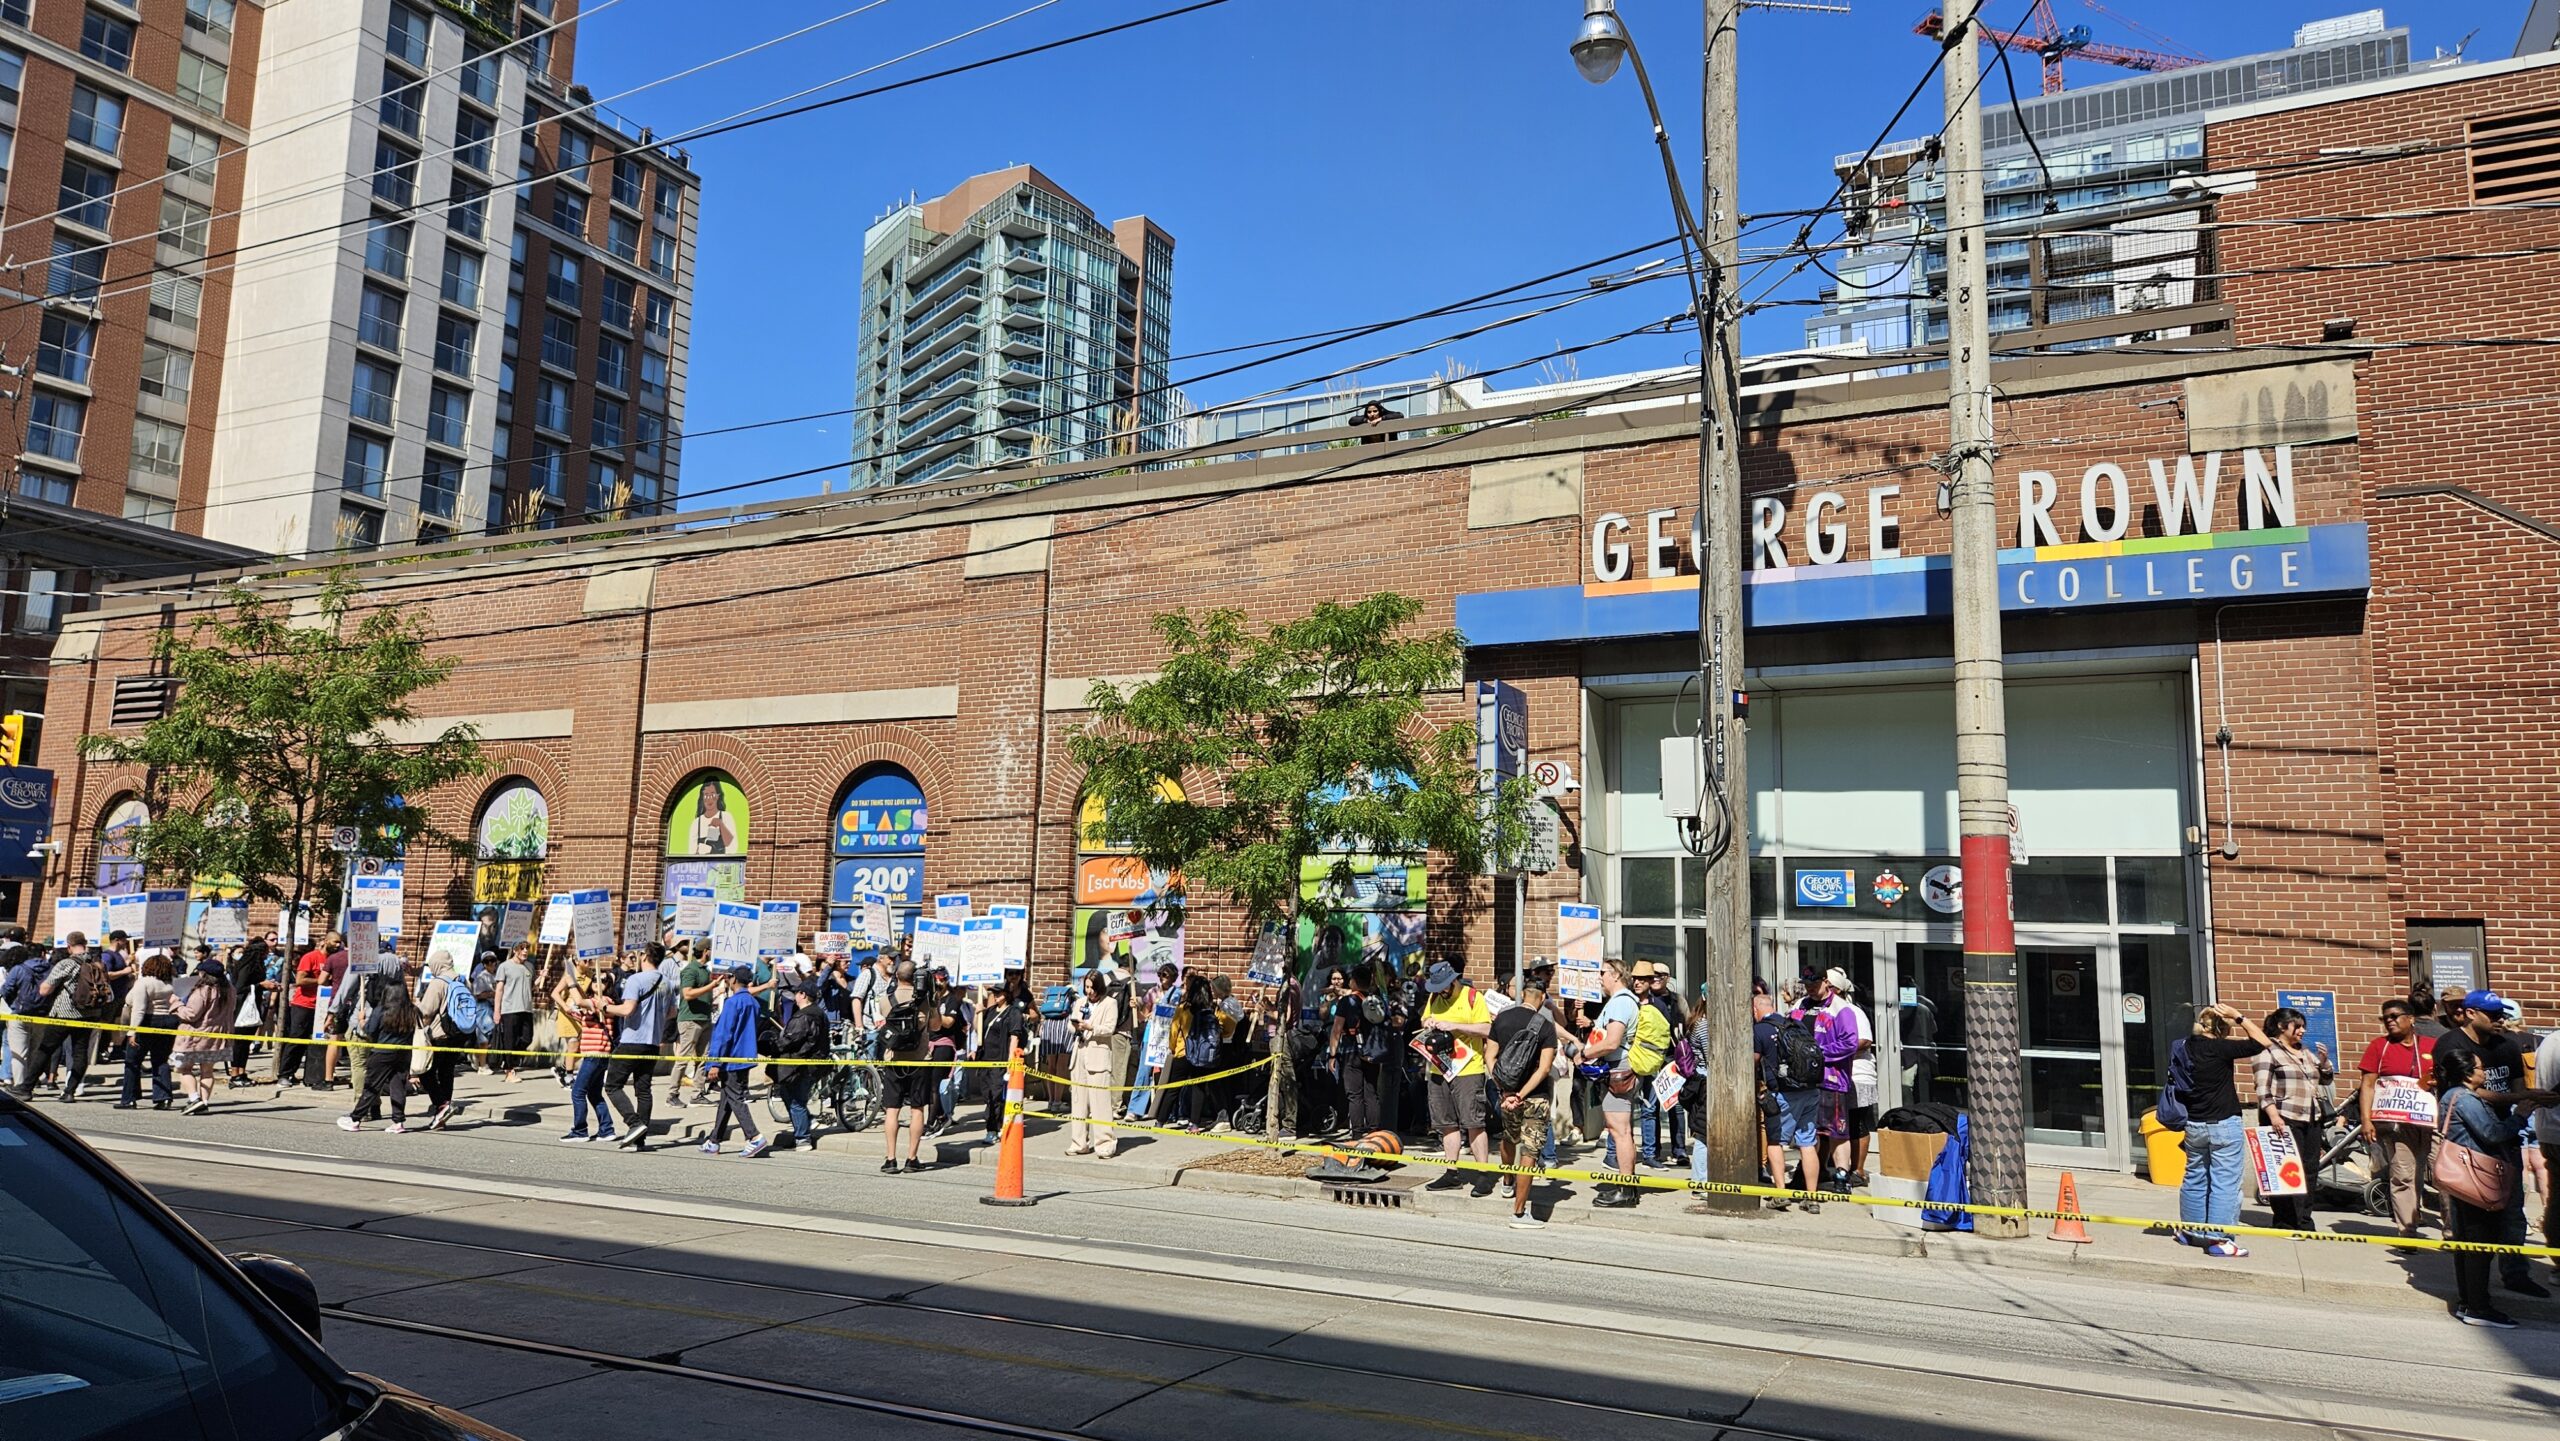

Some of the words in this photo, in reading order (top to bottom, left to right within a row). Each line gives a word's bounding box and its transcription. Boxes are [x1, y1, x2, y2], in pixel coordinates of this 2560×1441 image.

[1592, 486, 1900, 582] GERGE
[2018, 551, 2299, 604] COLLEGE
[1503, 707, 1525, 728] GEORGE
[6, 780, 47, 791] GEORGE
[10, 788, 48, 799] BROWN
[841, 809, 928, 832] CLASS
[840, 834, 859, 846] OF
[862, 833, 898, 846] YOUR
[671, 862, 708, 874] DOWN
[1806, 876, 1842, 885] GEORGE
[1811, 883, 1843, 892] BROWN
[628, 913, 637, 922] IN
[638, 912, 651, 922] MY
[626, 923, 647, 932] UNION
[724, 918, 746, 935] PAY
[1110, 919, 1124, 929] CUT
[1659, 1076, 1671, 1095] CUT
[2392, 1088, 2419, 1100] JUST
[2377, 1098, 2428, 1112] CONTRACT
[2267, 1131, 2286, 1156] CUT
[2282, 1131, 2297, 1156] DON'T
[1498, 1163, 1546, 1174] CAUTION
[2265, 1154, 2280, 1191] EDUCATION
[1590, 1172, 1641, 1184] CAUTION
[1687, 1181, 1742, 1193] CAUTION
[1792, 1190, 1851, 1202] CAUTION
[1903, 1200, 1966, 1212] CAUTION
[2023, 1210, 2090, 1222] CAUTION
